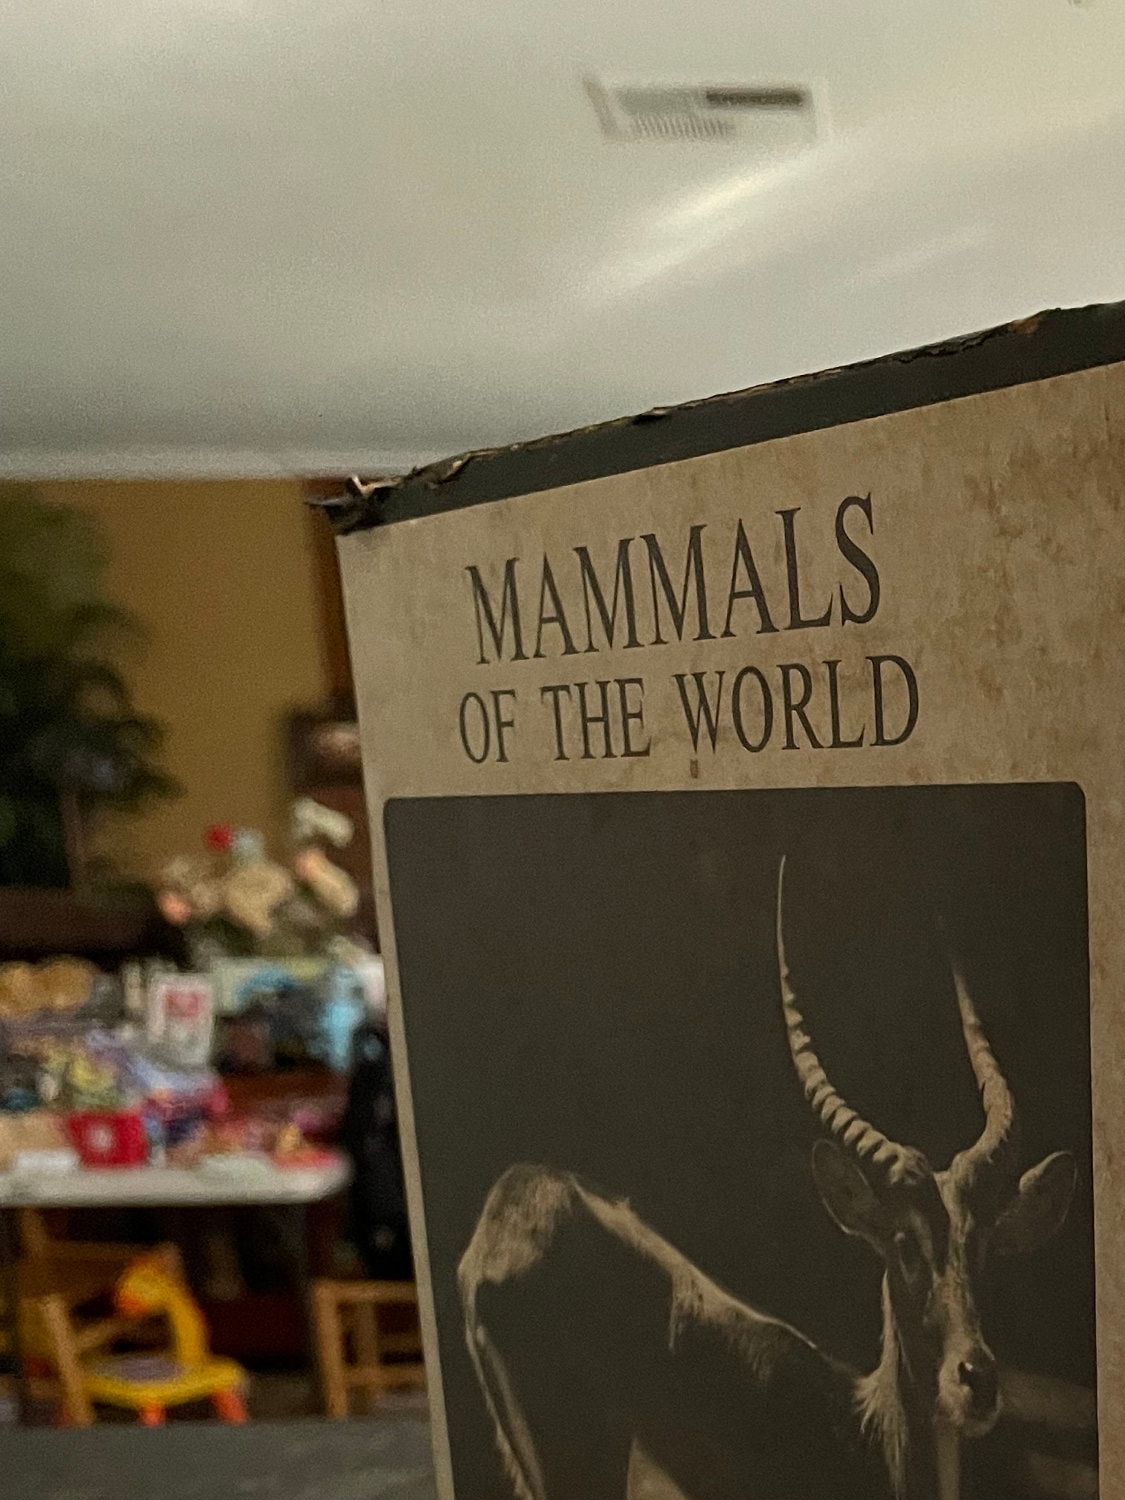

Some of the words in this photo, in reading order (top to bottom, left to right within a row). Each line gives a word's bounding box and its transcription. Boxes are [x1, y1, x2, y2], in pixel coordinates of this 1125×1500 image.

[465, 492, 881, 666] MAMMALS
[460, 689, 516, 763] OF
[541, 677, 652, 761] THE
[673, 654, 920, 754] WORLD
